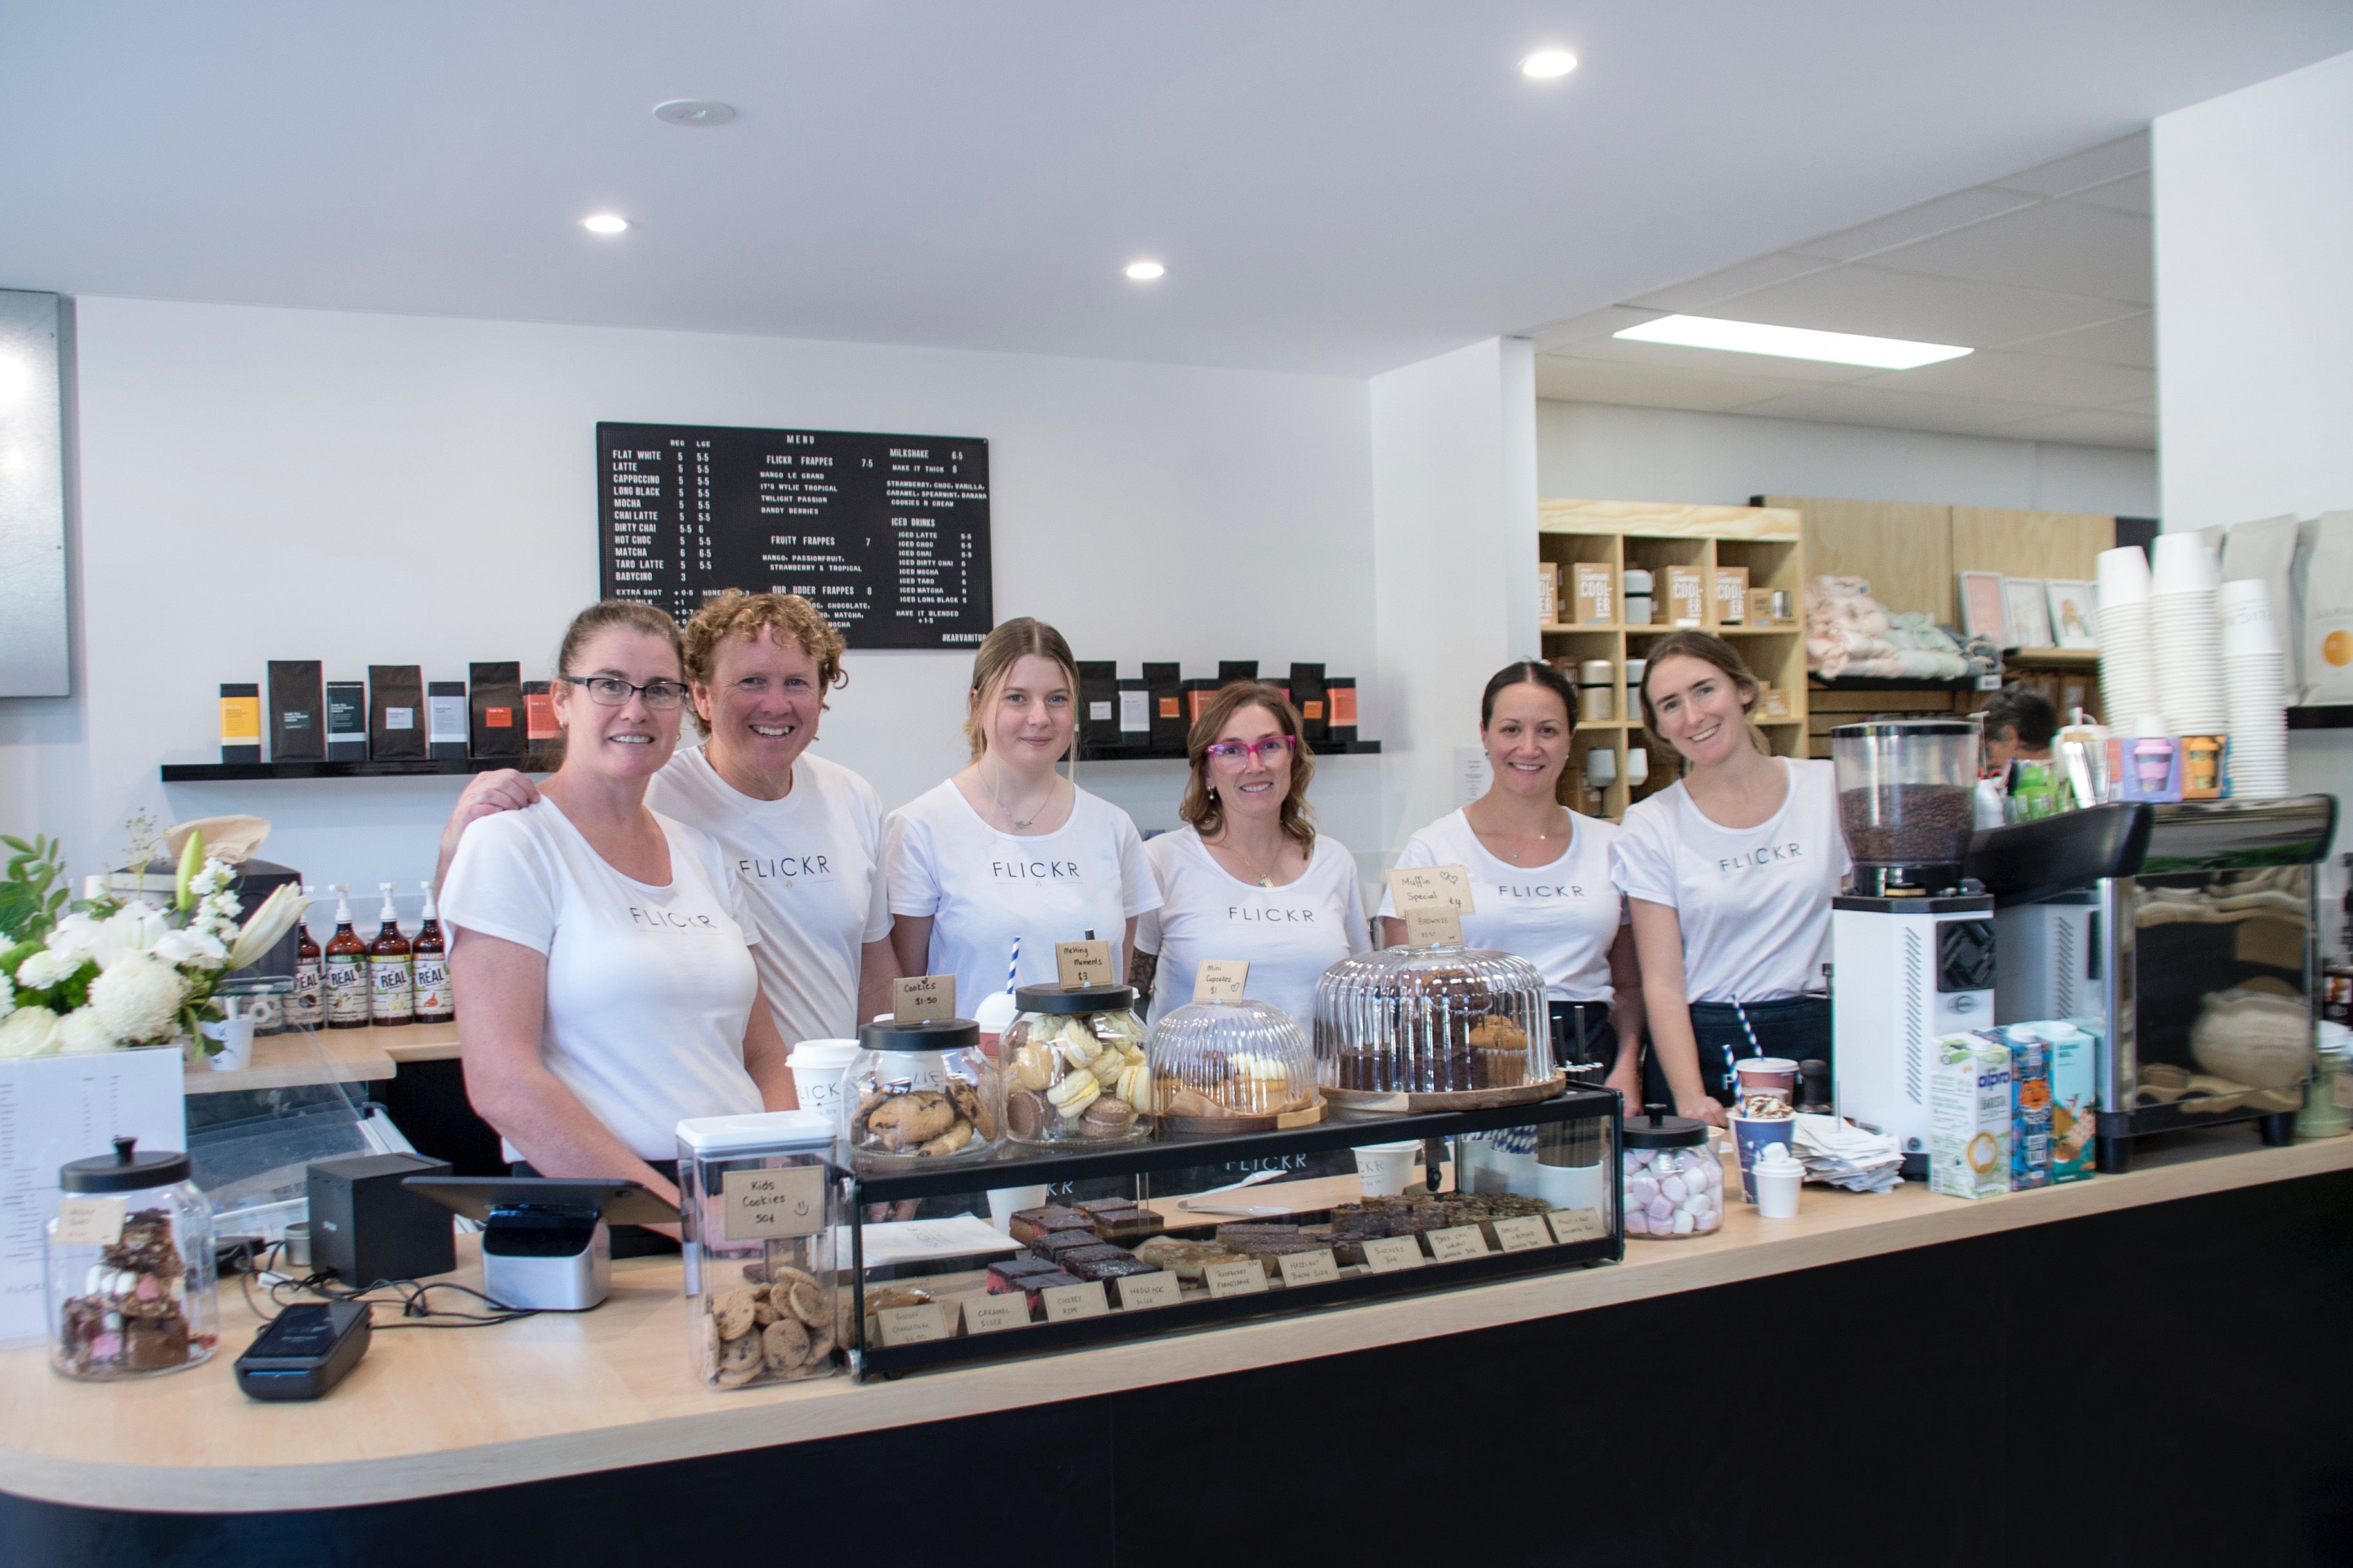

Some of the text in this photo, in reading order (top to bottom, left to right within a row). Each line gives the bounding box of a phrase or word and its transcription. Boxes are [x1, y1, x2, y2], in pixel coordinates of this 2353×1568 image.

[786, 434, 815, 444] MENU
[613, 449, 709, 462] FLAT WHITE 5 5.5
[890, 448, 963, 460] MILKSHAKE 6.5
[766, 455, 873, 468] FLICKR FRAPPES 7.5
[613, 462, 709, 474] LATTE 5 5.5
[613, 474, 710, 486] CAPPUCCINO 5 5.5
[613, 486, 710, 498] LONG BLACK 5 5.5
[614, 498, 710, 510] MOCHA 5 5.5
[614, 511, 710, 522] CHAI LATTE 5 5.5
[891, 517, 935, 527] ICED DRINKS
[614, 523, 703, 533] DIRTY CHAI 5.5 6
[614, 535, 711, 546] HOT CHOC 5 5.5
[771, 536, 870, 547] FRUITY FRAPPES 7
[615, 547, 711, 558] MATCHA 6 6.5
[616, 560, 712, 570] TARO LATTE 5 5.5
[616, 572, 686, 582] BABYCINO 3
[772, 585, 872, 596] OUR UDDER FRAPPES 8
[1720, 842, 1802, 872] FLICKR
[739, 855, 831, 878] FLICKR
[992, 861, 1080, 879] FLICKR
[1402, 876, 1431, 888] Muffin
[1407, 891, 1438, 902] Special
[1498, 883, 1585, 898] FLICKR
[629, 906, 717, 930] FLICKR
[1228, 904, 1314, 923] FLICKR
[1418, 917, 1448, 925] BROWNIE
[299, 972, 319, 989] EAL
[331, 969, 357, 985] REAL
[381, 970, 407, 988] REAL
[419, 968, 444, 985] REAL
[1078, 972, 1088, 981] $3
[1206, 975, 1232, 983] Cupcakes
[904, 982, 937, 992] Cookies
[1210, 987, 1217, 995] $1
[1977, 1068, 2010, 1091] alpro
[799, 1082, 840, 1100] LICK
[751, 1180, 775, 1191] Kids
[742, 1195, 786, 1207] Cookies
[1057, 1296, 1082, 1305] CHERRY
[978, 1308, 1010, 1317] CARAMEL
[981, 1318, 1002, 1327] SLICE
